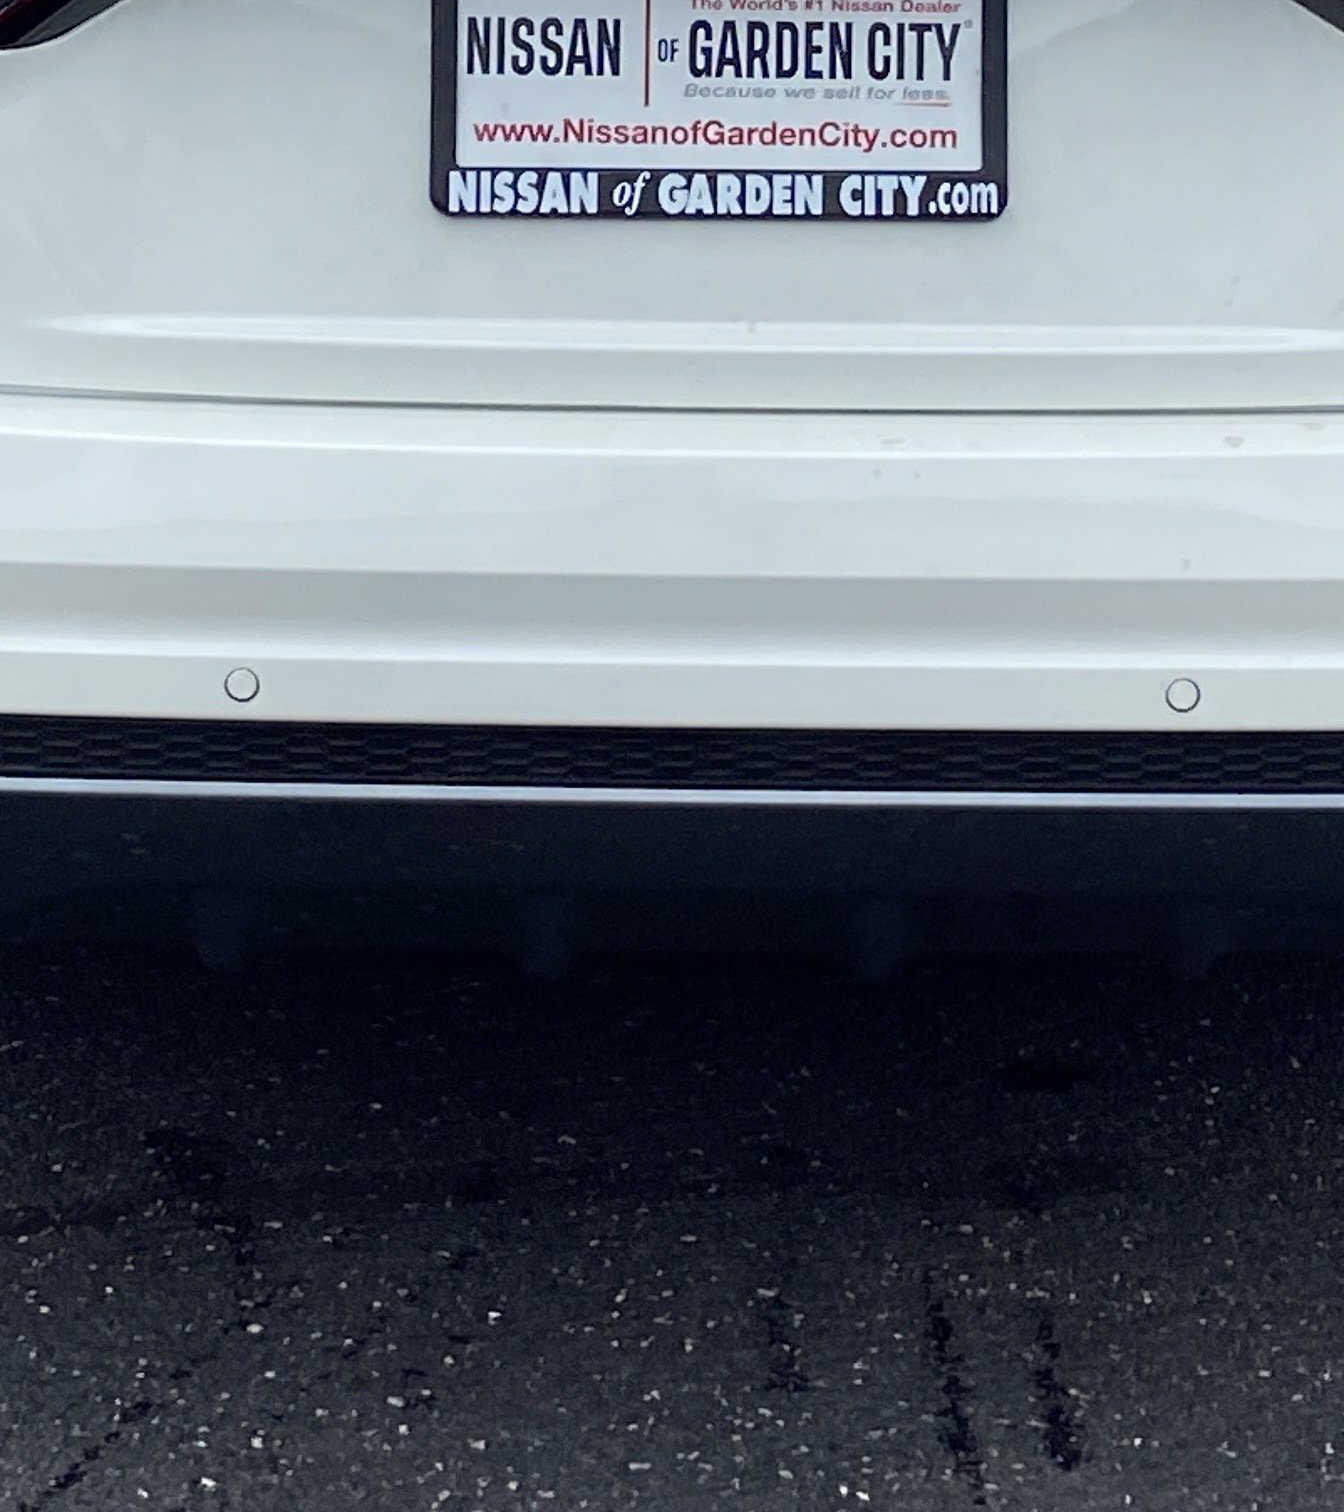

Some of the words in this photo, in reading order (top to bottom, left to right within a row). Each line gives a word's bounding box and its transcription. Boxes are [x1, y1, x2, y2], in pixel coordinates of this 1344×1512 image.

[465, 16, 622, 77] NISSAN
[657, 38, 680, 63] OF
[688, 19, 854, 80] GARDEN
[866, 21, 962, 82] CITY
[683, 82, 777, 99] Because
[784, 87, 816, 100] we
[822, 86, 861, 101] sell
[867, 86, 896, 101] for
[472, 117, 958, 154] www.NissanofGardenCity.com
[448, 170, 600, 214] NISSAN
[612, 170, 652, 217] of
[657, 172, 824, 216] GARDEN
